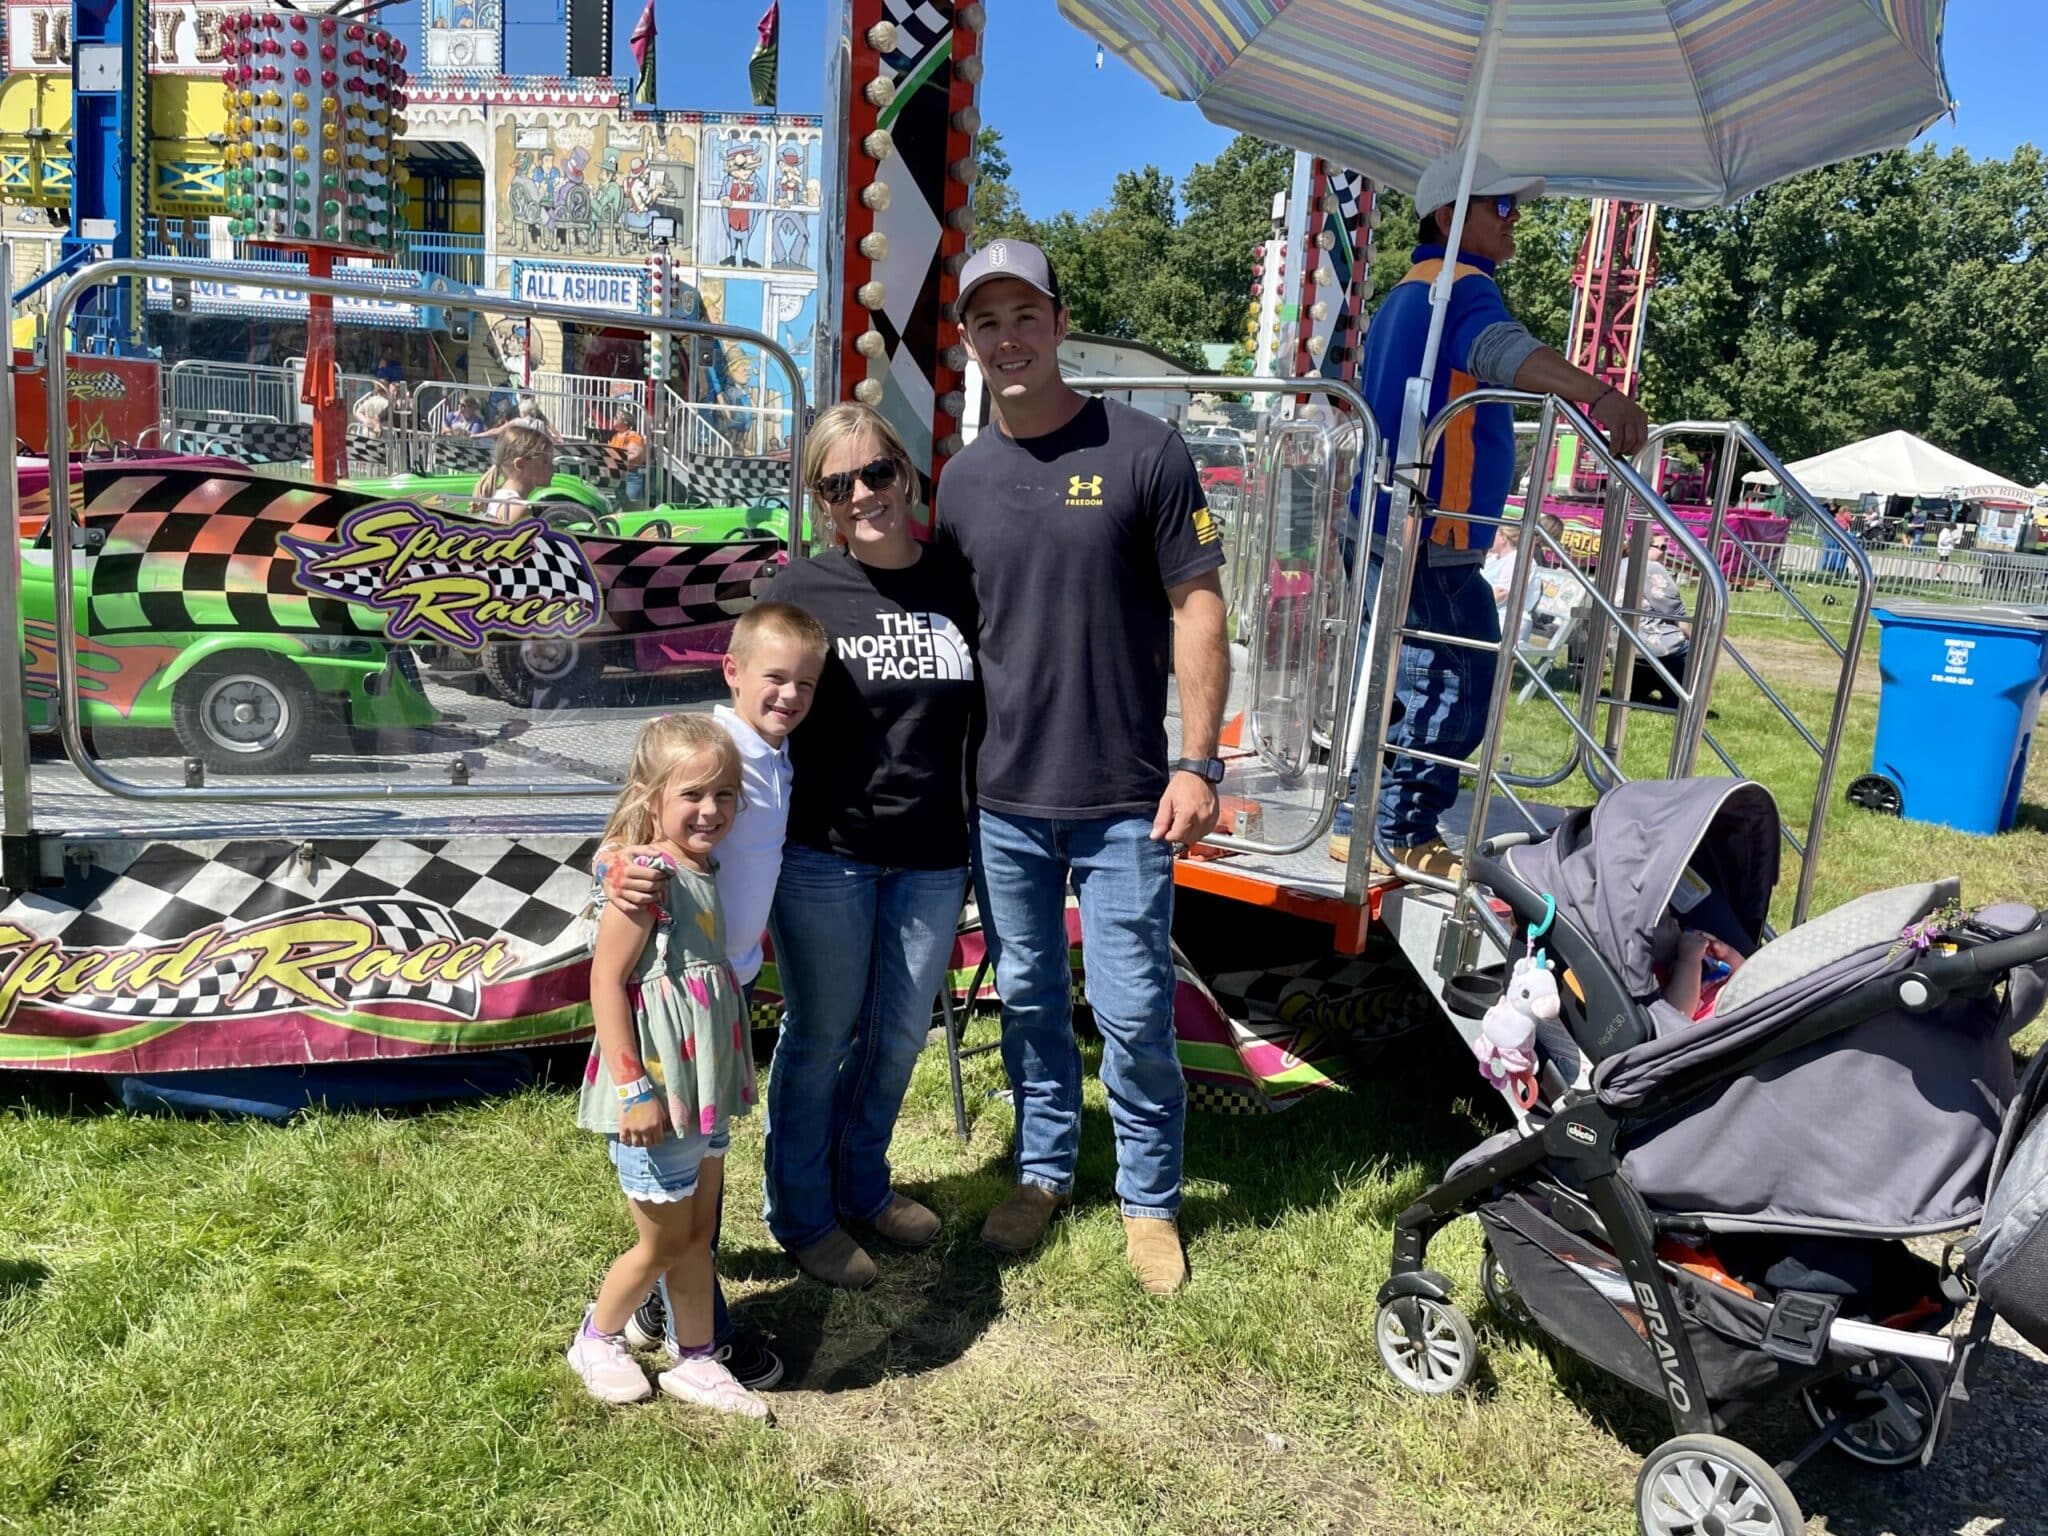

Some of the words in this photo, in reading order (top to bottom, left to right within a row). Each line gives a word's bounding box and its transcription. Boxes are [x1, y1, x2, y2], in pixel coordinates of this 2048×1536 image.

[526, 274, 558, 298] ALL
[562, 276, 632, 304] ASHORE
[1065, 498, 1103, 506] FREEDOM
[310, 511, 544, 585] Speed
[384, 578, 591, 641] Racer
[876, 612, 929, 635] THE
[837, 634, 934, 660] NORTH
[866, 656, 936, 681] FACE
[206, 914, 512, 1010] Racer
[1634, 1280, 1691, 1412] BRAVO
